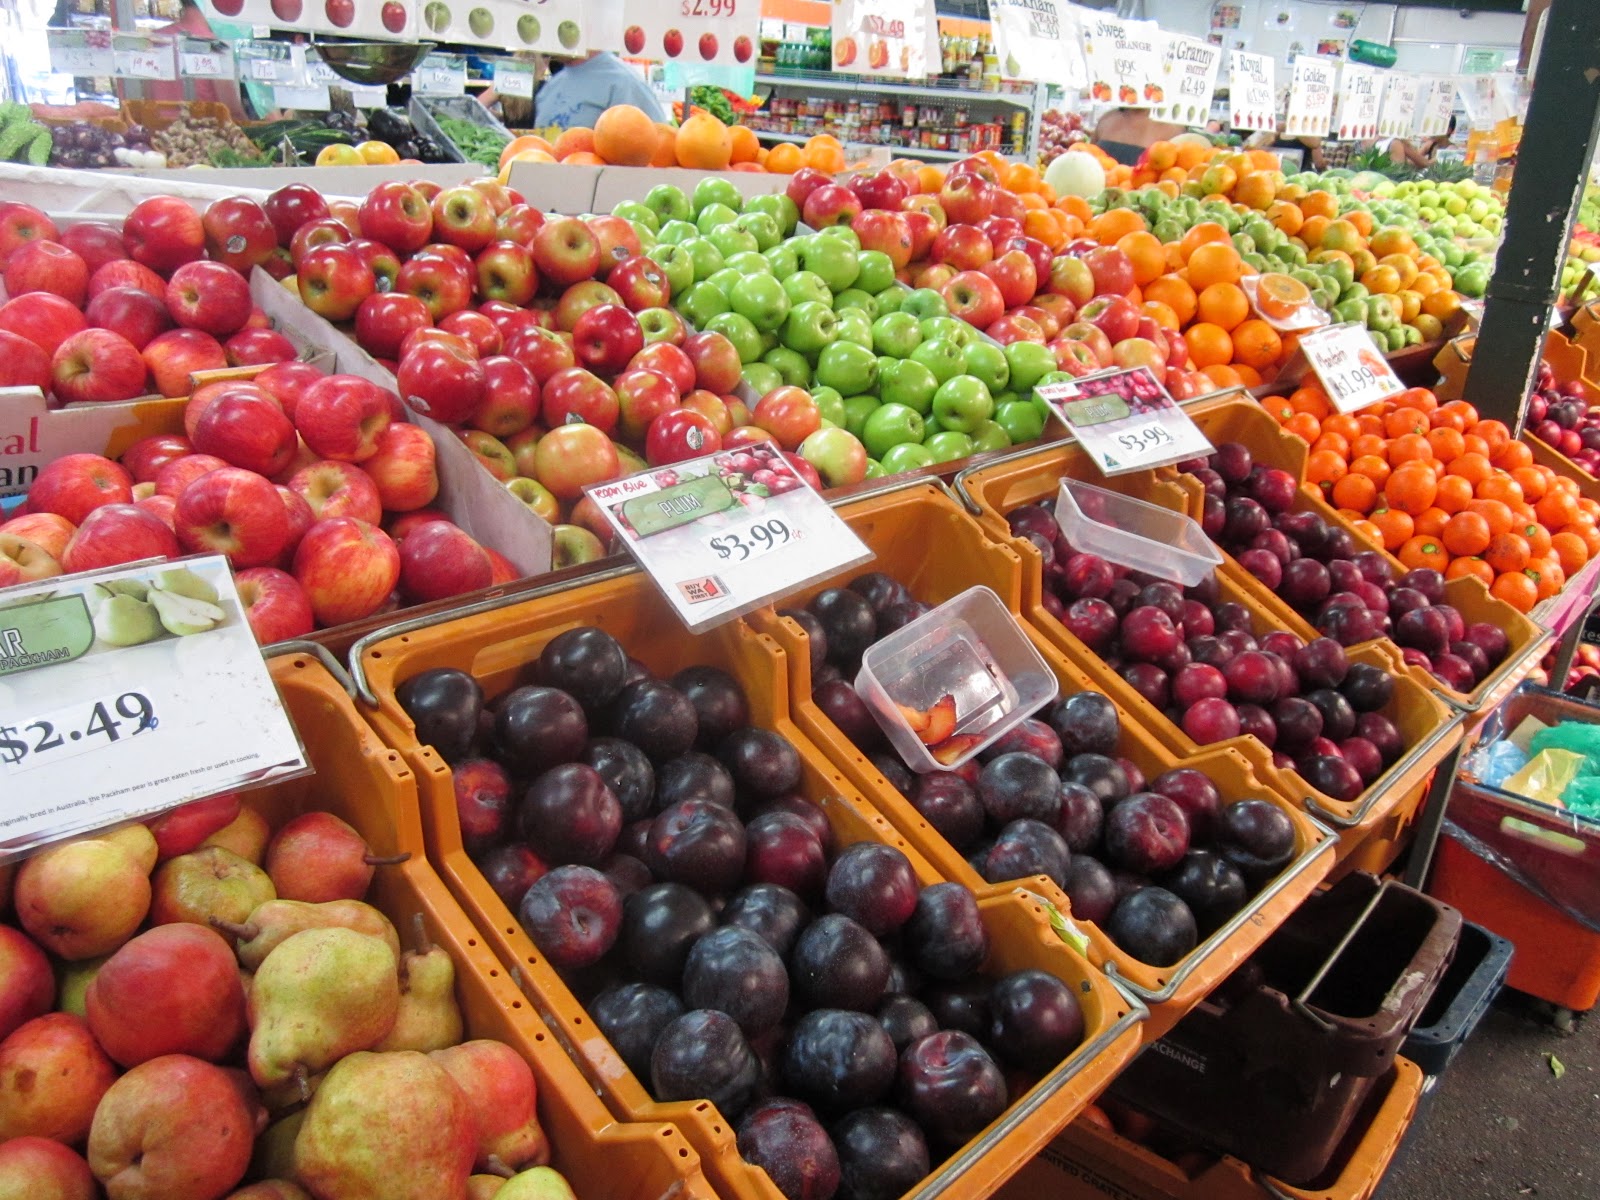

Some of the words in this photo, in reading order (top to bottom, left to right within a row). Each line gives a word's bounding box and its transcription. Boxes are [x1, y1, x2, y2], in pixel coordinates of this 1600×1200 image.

[1096, 20, 1127, 39] Swee
[1115, 40, 1152, 51] ORANGE
[1177, 41, 1214, 71] Granny
[1303, 68, 1327, 84] Golden
[1356, 76, 1374, 94] Pink
[1118, 426, 1169, 452] $3.99
[622, 480, 647, 493] Blue
[658, 493, 702, 518] PLUM
[709, 519, 790, 561] $3.99
[685, 582, 701, 590] BUY
[690, 592, 709, 600] FIRST
[0, 647, 70, 671] PACKHAM
[0, 692, 154, 765] $2.49
[30, 810, 47, 819] bred
[88, 795, 100, 803] the
[101, 787, 131, 799] Packham
[132, 783, 146, 792] pear
[154, 776, 170, 786] great
[171, 771, 189, 781] eaten
[189, 766, 205, 776] fresh
[214, 760, 229, 769] used
